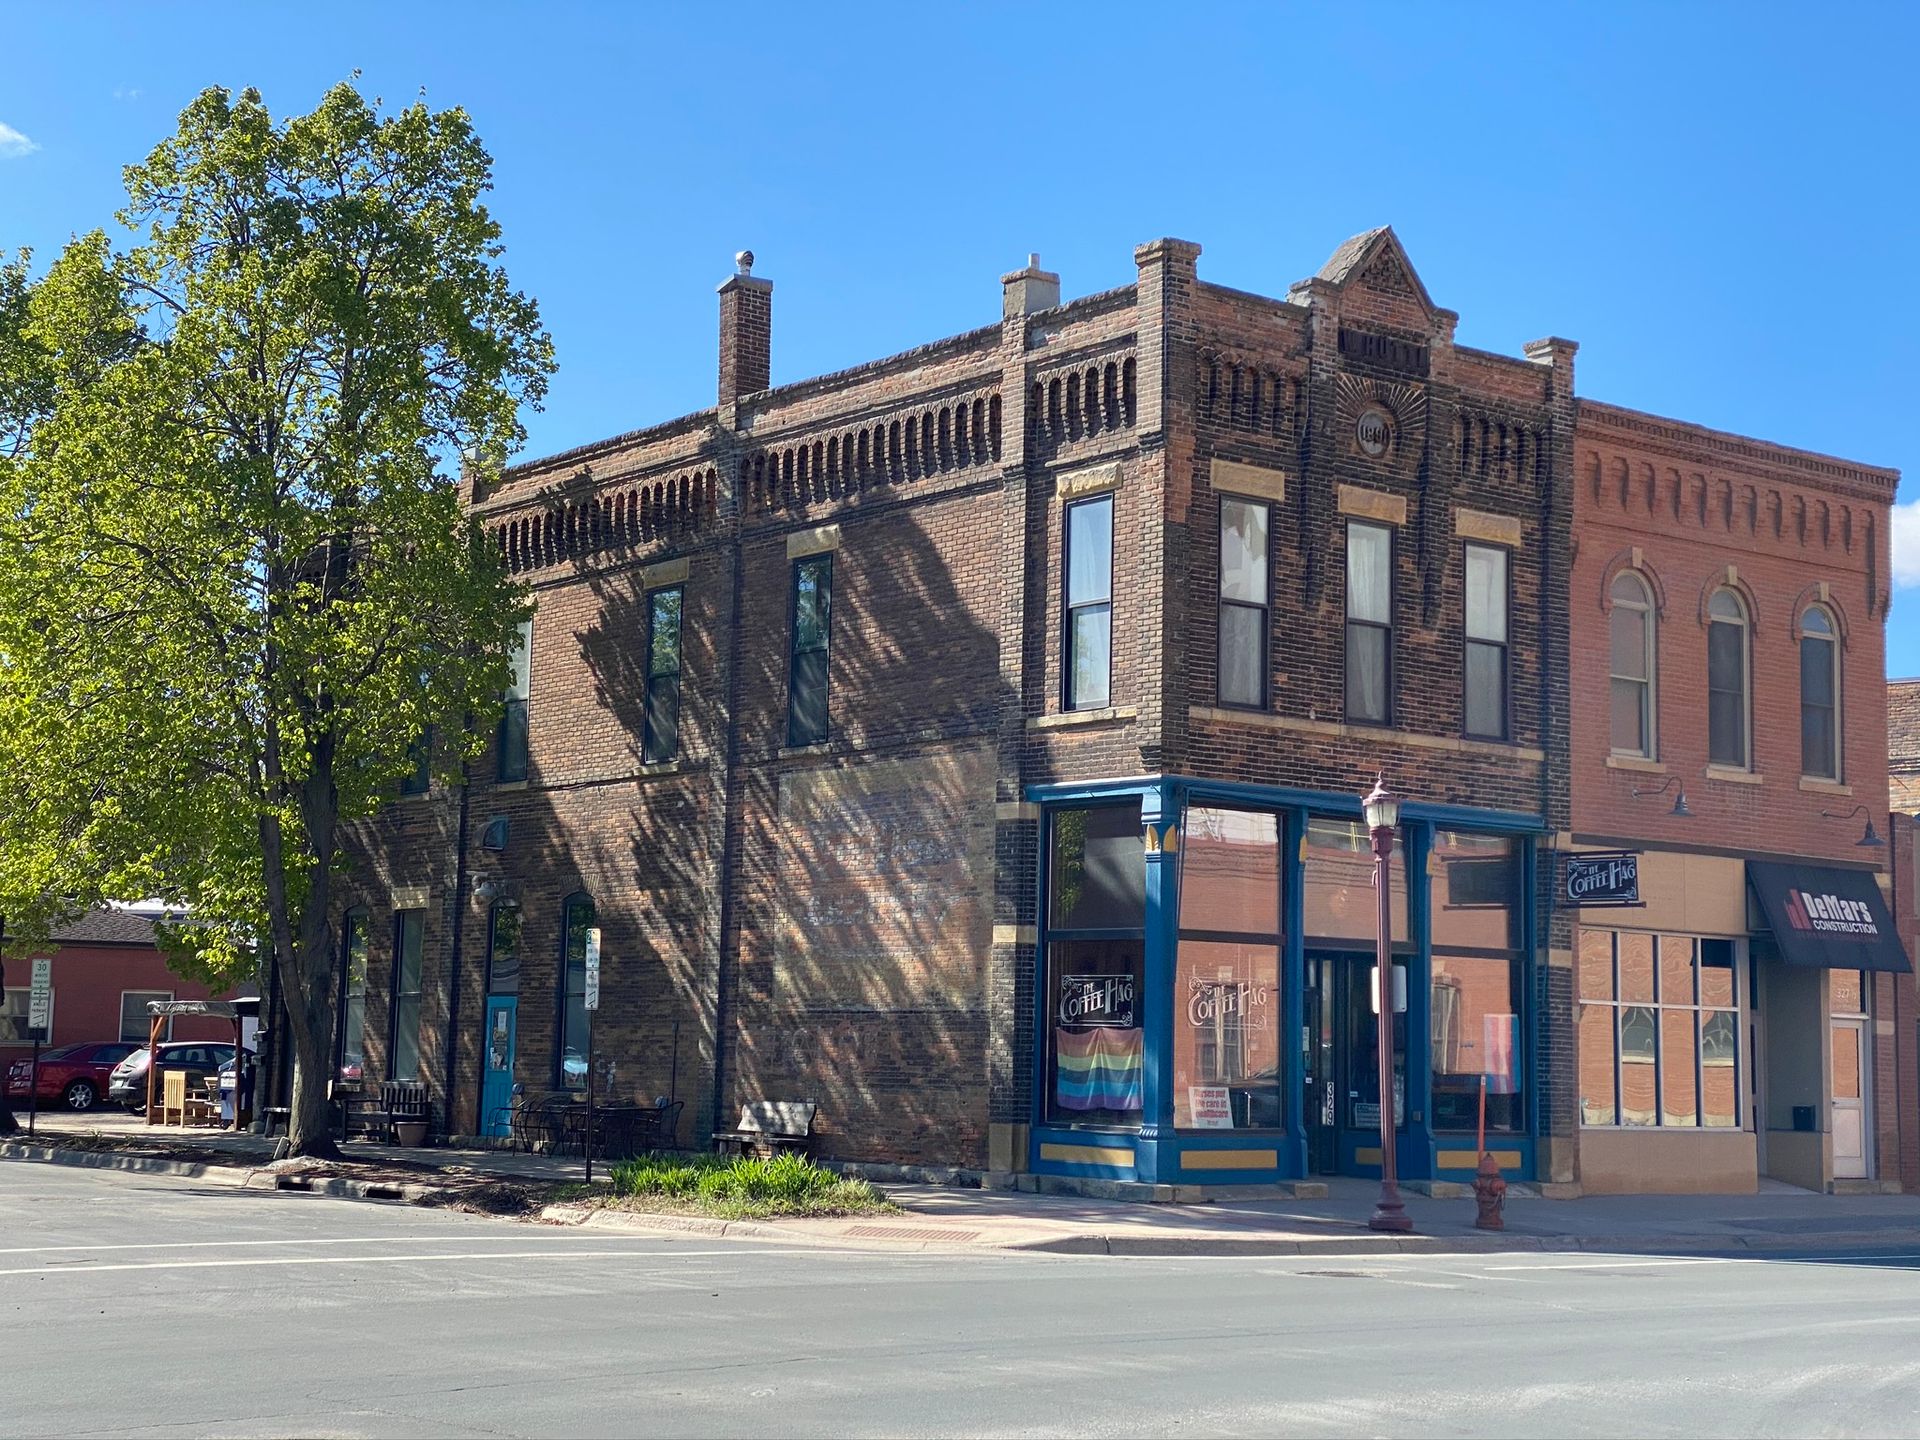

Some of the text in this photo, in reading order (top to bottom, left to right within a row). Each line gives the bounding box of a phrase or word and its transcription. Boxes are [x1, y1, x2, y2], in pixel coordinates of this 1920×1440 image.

[1567, 860, 1636, 899] COFFEE HAG
[1801, 892, 1873, 923] DeMars
[1813, 920, 1878, 934] CONSTRUCTION
[37, 963, 47, 972] 30
[1060, 978, 1133, 1023] COFFEE HAG
[1188, 982, 1267, 1026] COFFEE HAG
